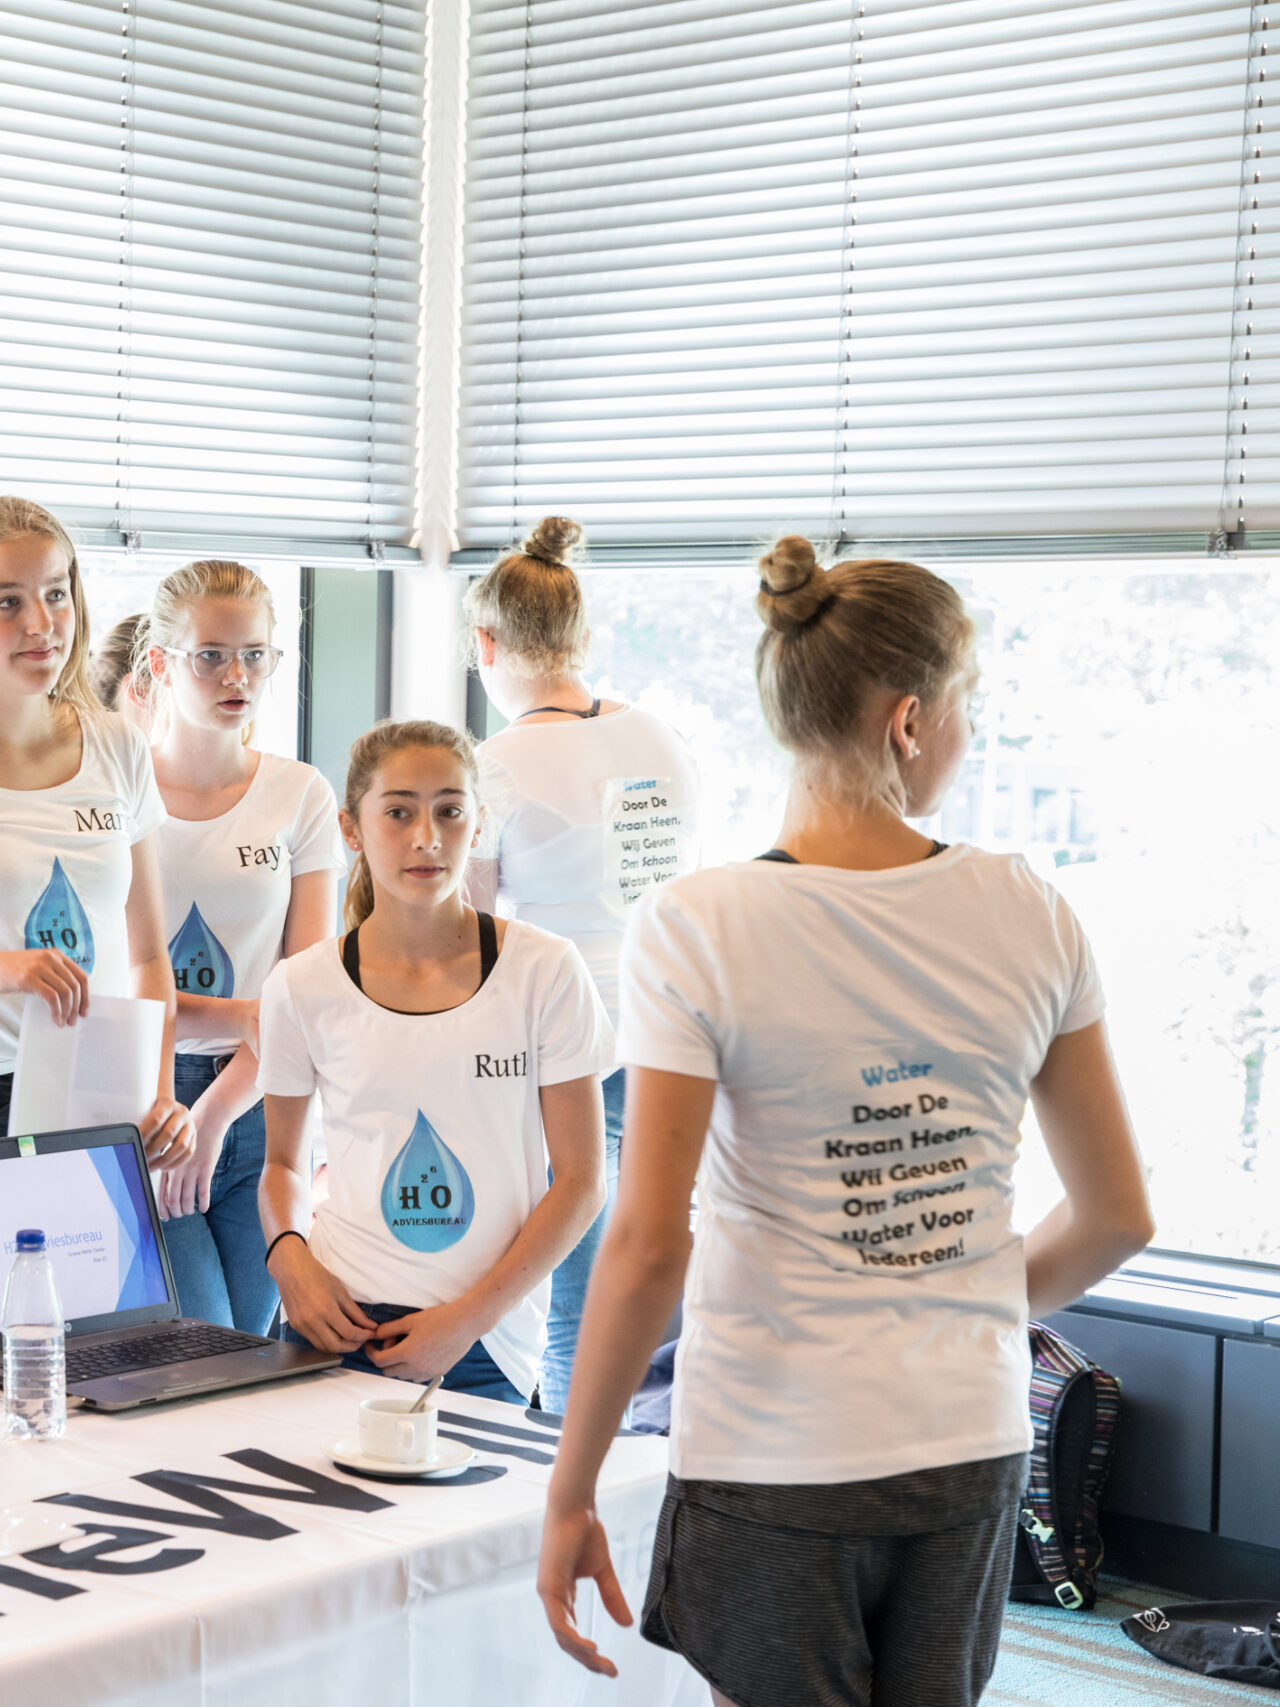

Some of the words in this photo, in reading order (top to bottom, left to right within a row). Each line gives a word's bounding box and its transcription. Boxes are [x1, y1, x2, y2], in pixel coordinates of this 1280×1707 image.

[621, 800, 648, 811] Door
[650, 796, 668, 808] De
[613, 820, 648, 832] Kraan
[235, 845, 281, 870] Fay
[861, 1061, 933, 1087] Water
[852, 1102, 913, 1124] Door
[918, 1093, 950, 1115] De
[824, 1137, 904, 1159] Kraan
[842, 1198, 887, 1218] Om
[920, 1208, 974, 1231] Voor
